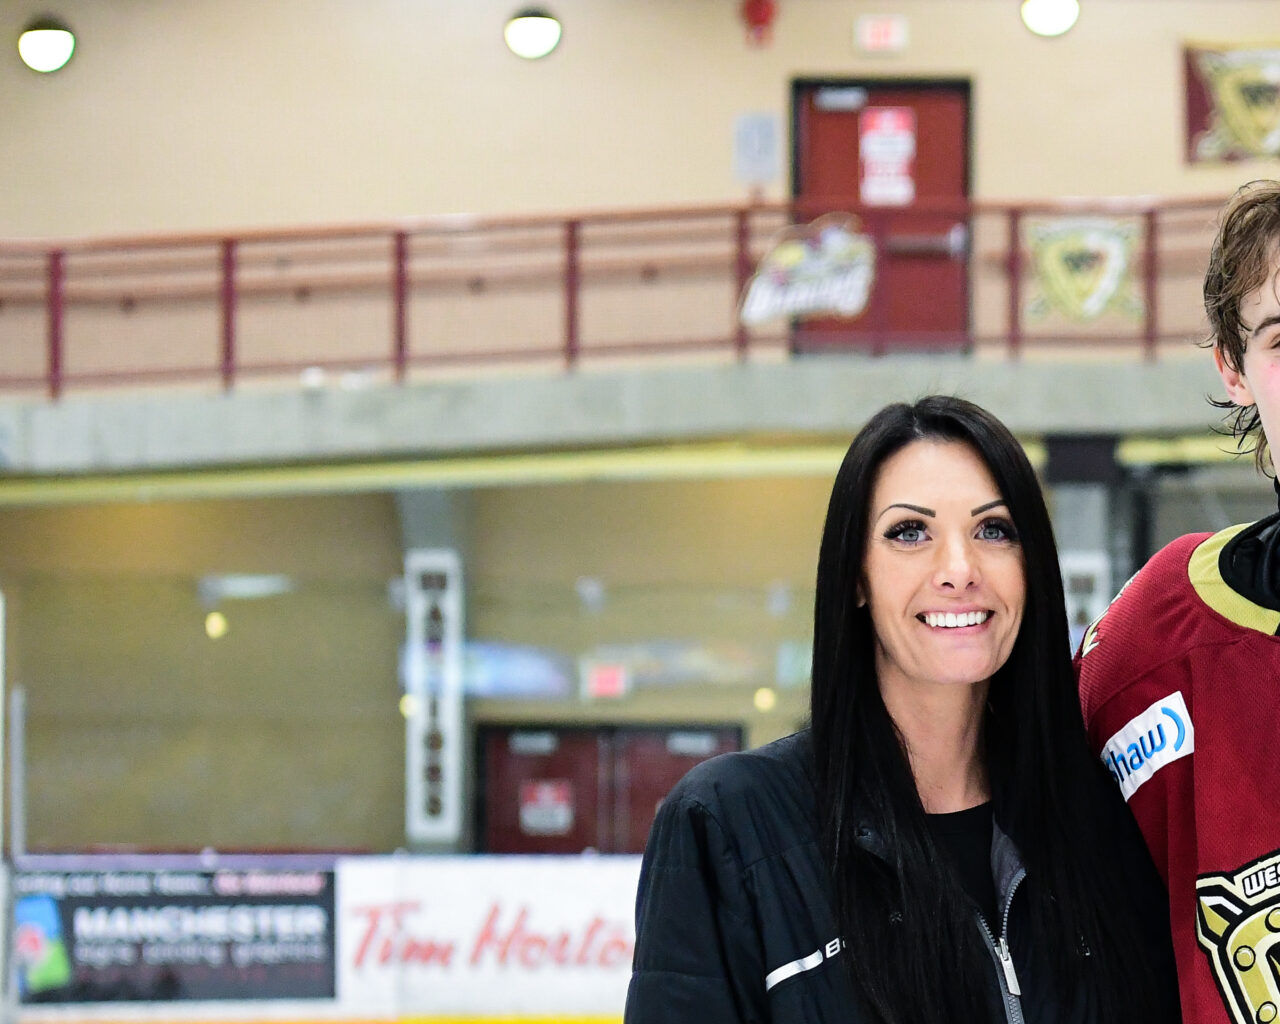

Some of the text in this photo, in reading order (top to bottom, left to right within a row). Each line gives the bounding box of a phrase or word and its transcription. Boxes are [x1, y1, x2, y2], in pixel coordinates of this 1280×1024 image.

[73, 904, 327, 939] MANCHESTER
[350, 897, 634, 968] Tim Horto
